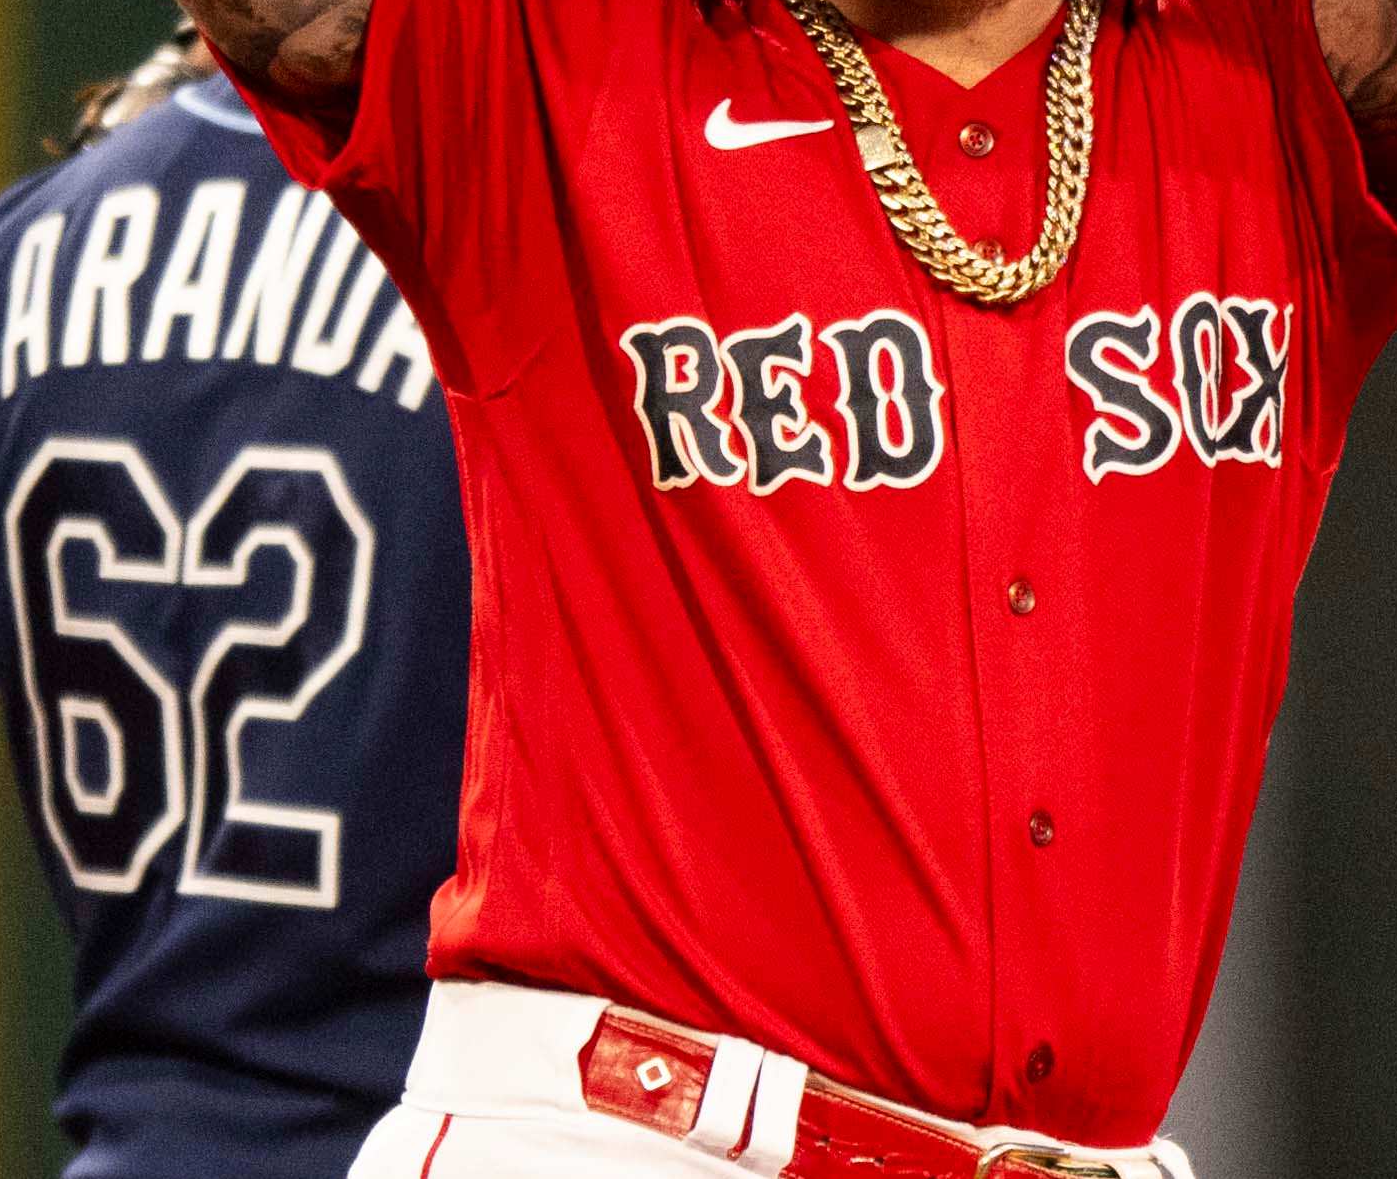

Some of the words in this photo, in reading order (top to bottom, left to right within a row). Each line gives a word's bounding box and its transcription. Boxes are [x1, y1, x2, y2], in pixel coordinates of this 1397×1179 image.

[619, 310, 945, 497] RED
[1065, 292, 1294, 486] SOX
[6, 437, 374, 908] 62
